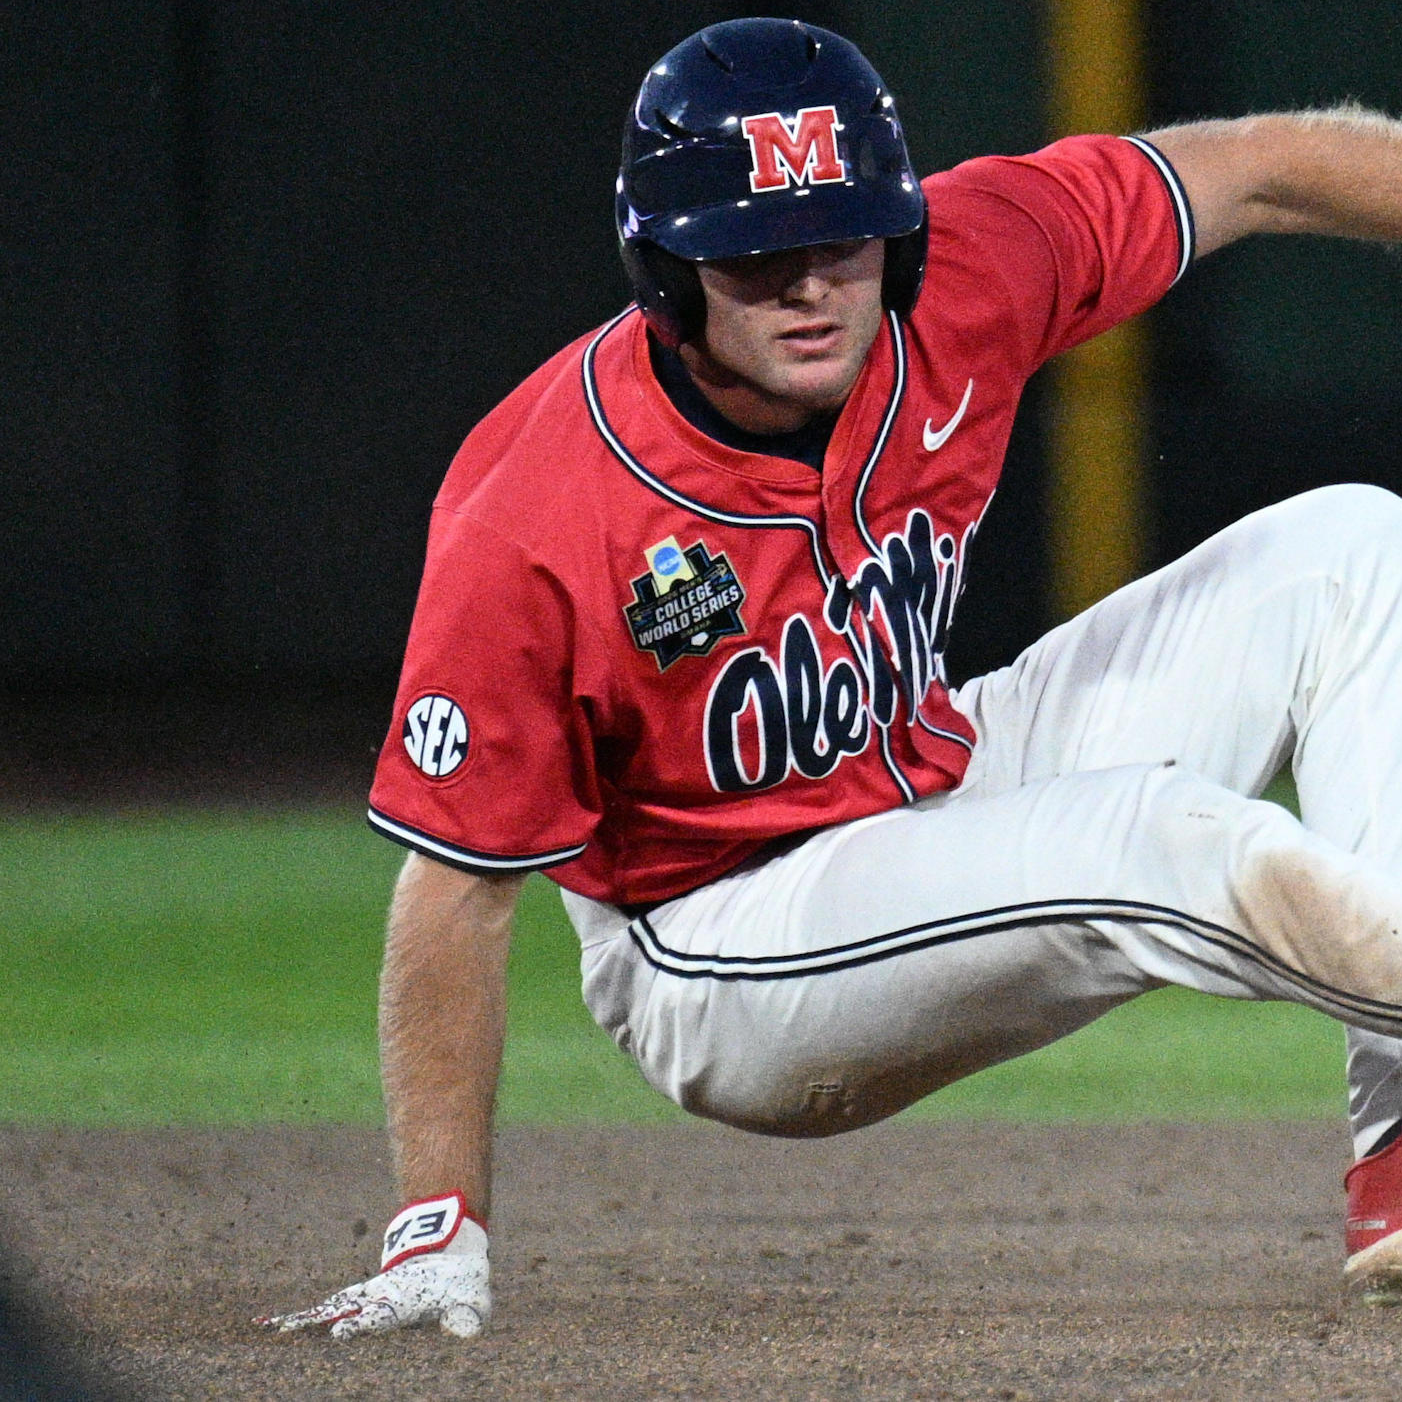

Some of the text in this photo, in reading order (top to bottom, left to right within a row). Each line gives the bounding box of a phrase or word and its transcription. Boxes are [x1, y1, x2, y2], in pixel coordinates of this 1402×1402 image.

[741, 105, 845, 193] M
[638, 611, 691, 647] WORLD
[691, 584, 739, 623] SERIES
[655, 580, 714, 623] COLLEGE
[703, 507, 976, 793] Ole Mi
[403, 696, 467, 776] SEC
